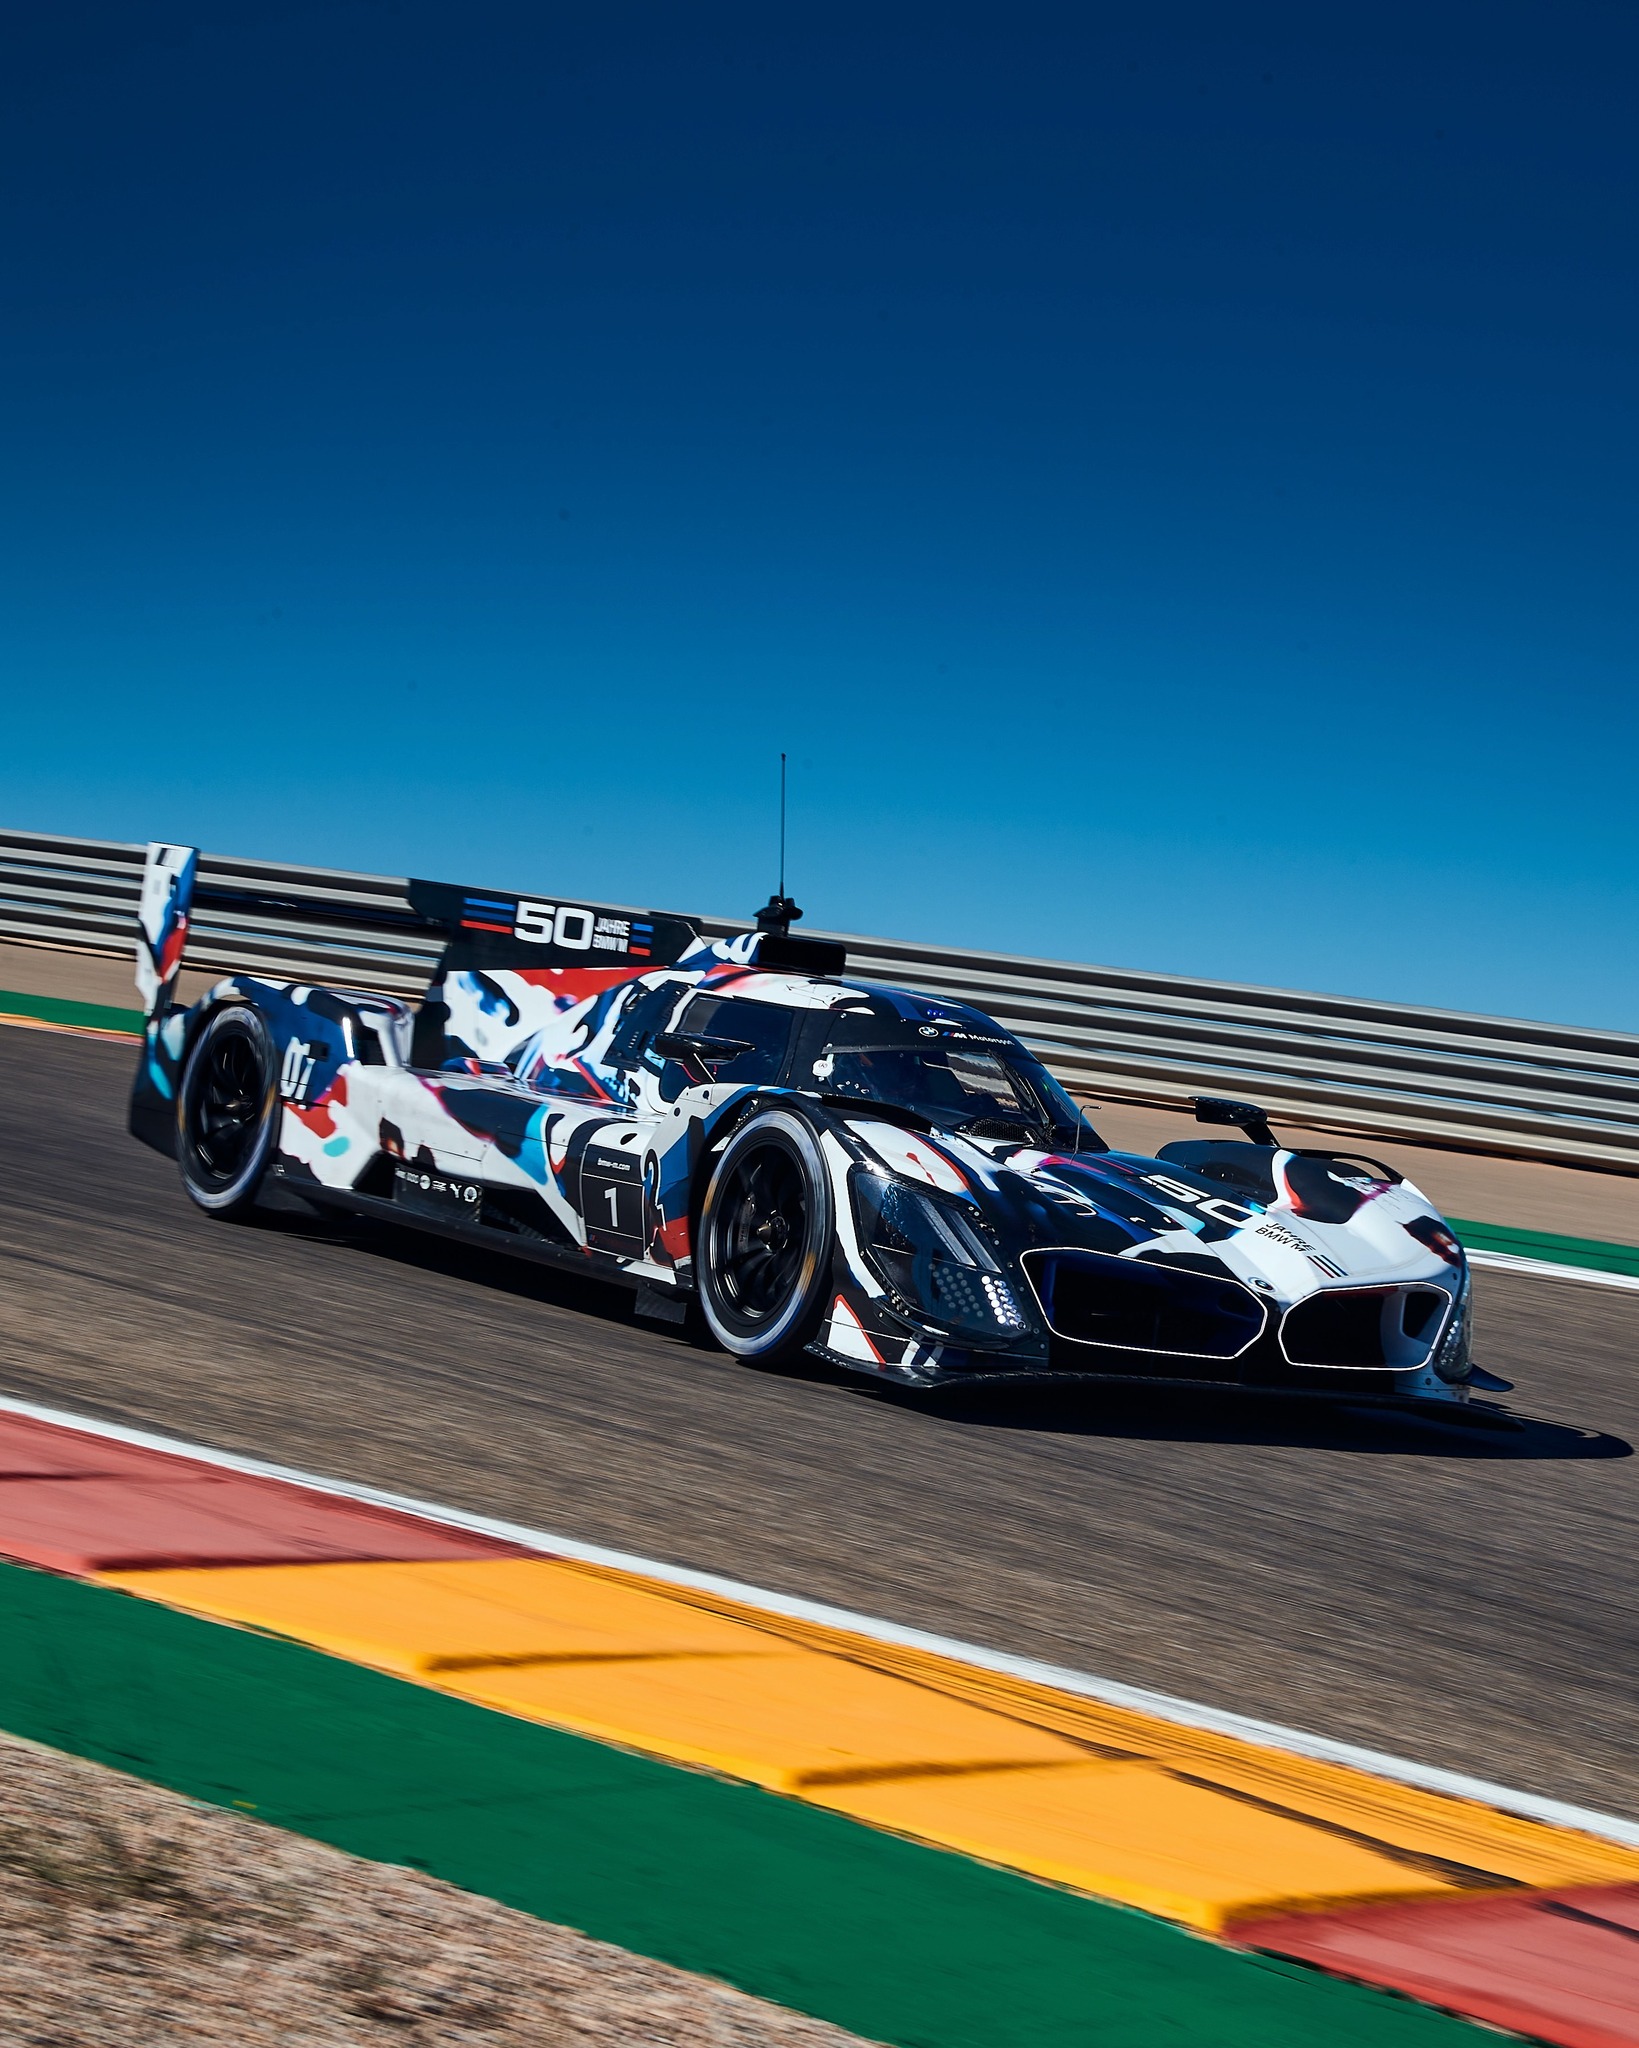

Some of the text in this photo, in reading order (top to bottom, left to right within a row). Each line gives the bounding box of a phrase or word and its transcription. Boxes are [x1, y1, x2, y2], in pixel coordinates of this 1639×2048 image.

[514, 901, 595, 950] 50
[594, 917, 631, 936] JAHRE
[968, 1034, 1015, 1046] Motorsport
[604, 1186, 619, 1228] 1
[1139, 1174, 1257, 1229] 50
[1255, 1227, 1307, 1252] BMW M
[1265, 1222, 1317, 1251] JAHRE
